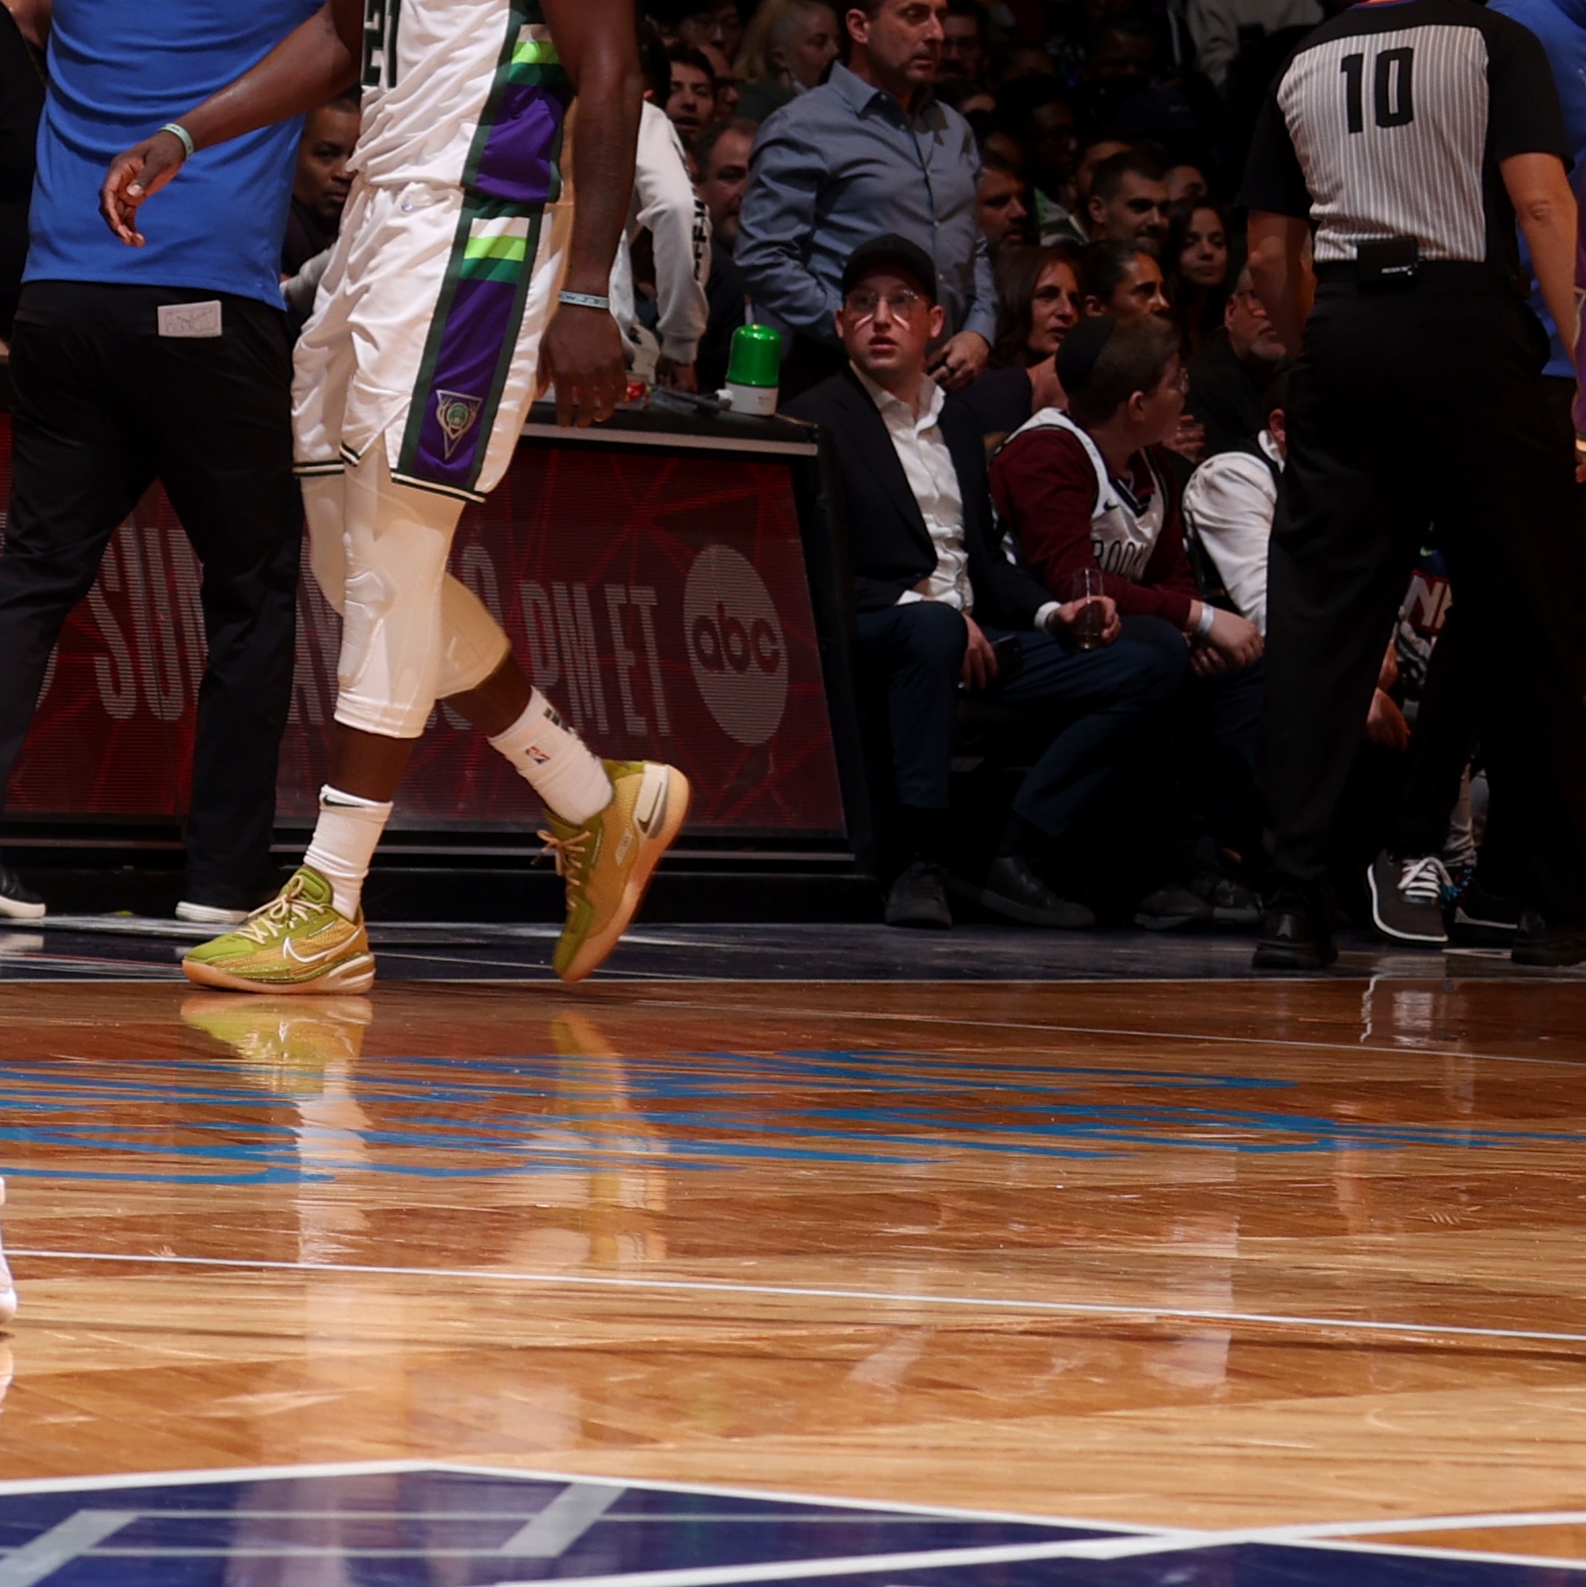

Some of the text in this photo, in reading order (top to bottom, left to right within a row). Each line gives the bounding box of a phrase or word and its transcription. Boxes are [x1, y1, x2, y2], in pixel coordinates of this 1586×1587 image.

[1340, 45, 1415, 136] 10
[519, 579, 610, 734] PM
[604, 583, 671, 737] ET
[692, 600, 780, 673] abc
